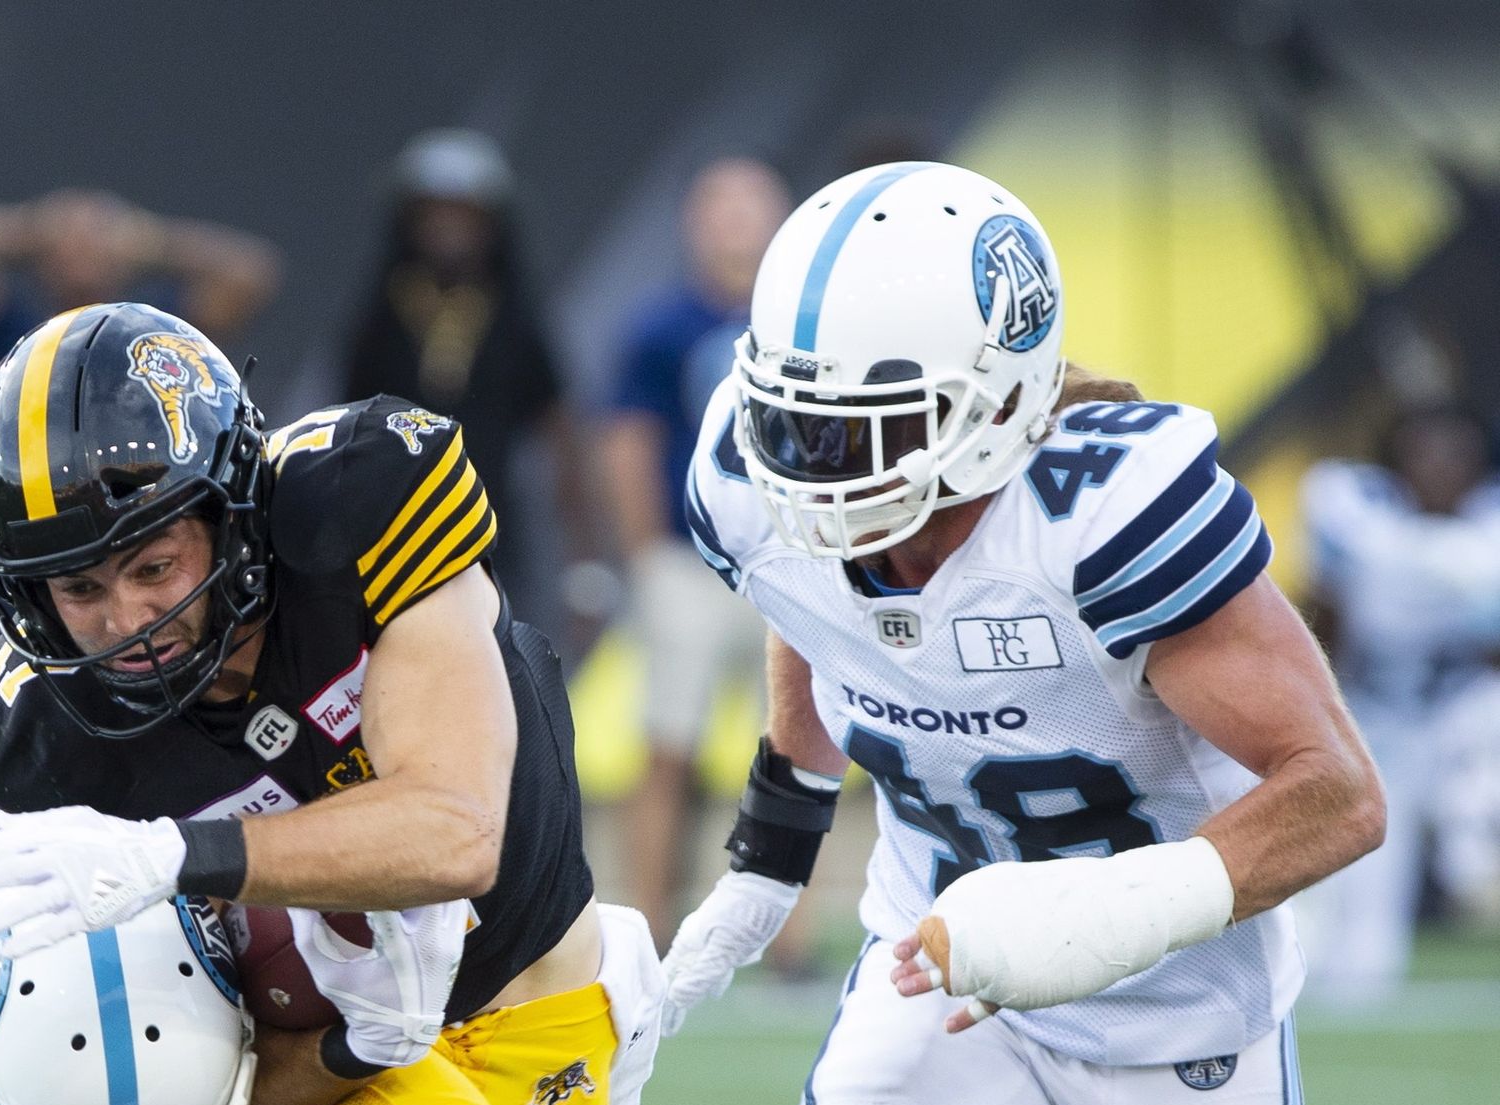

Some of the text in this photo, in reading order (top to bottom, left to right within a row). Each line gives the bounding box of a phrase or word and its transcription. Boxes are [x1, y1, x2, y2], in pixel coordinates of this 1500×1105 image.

[1023, 400, 1183, 523] 48
[883, 619, 915, 640] CFL
[316, 703, 353, 732] Tim
[841, 683, 1029, 736] TORONTO
[255, 718, 289, 752] CFL
